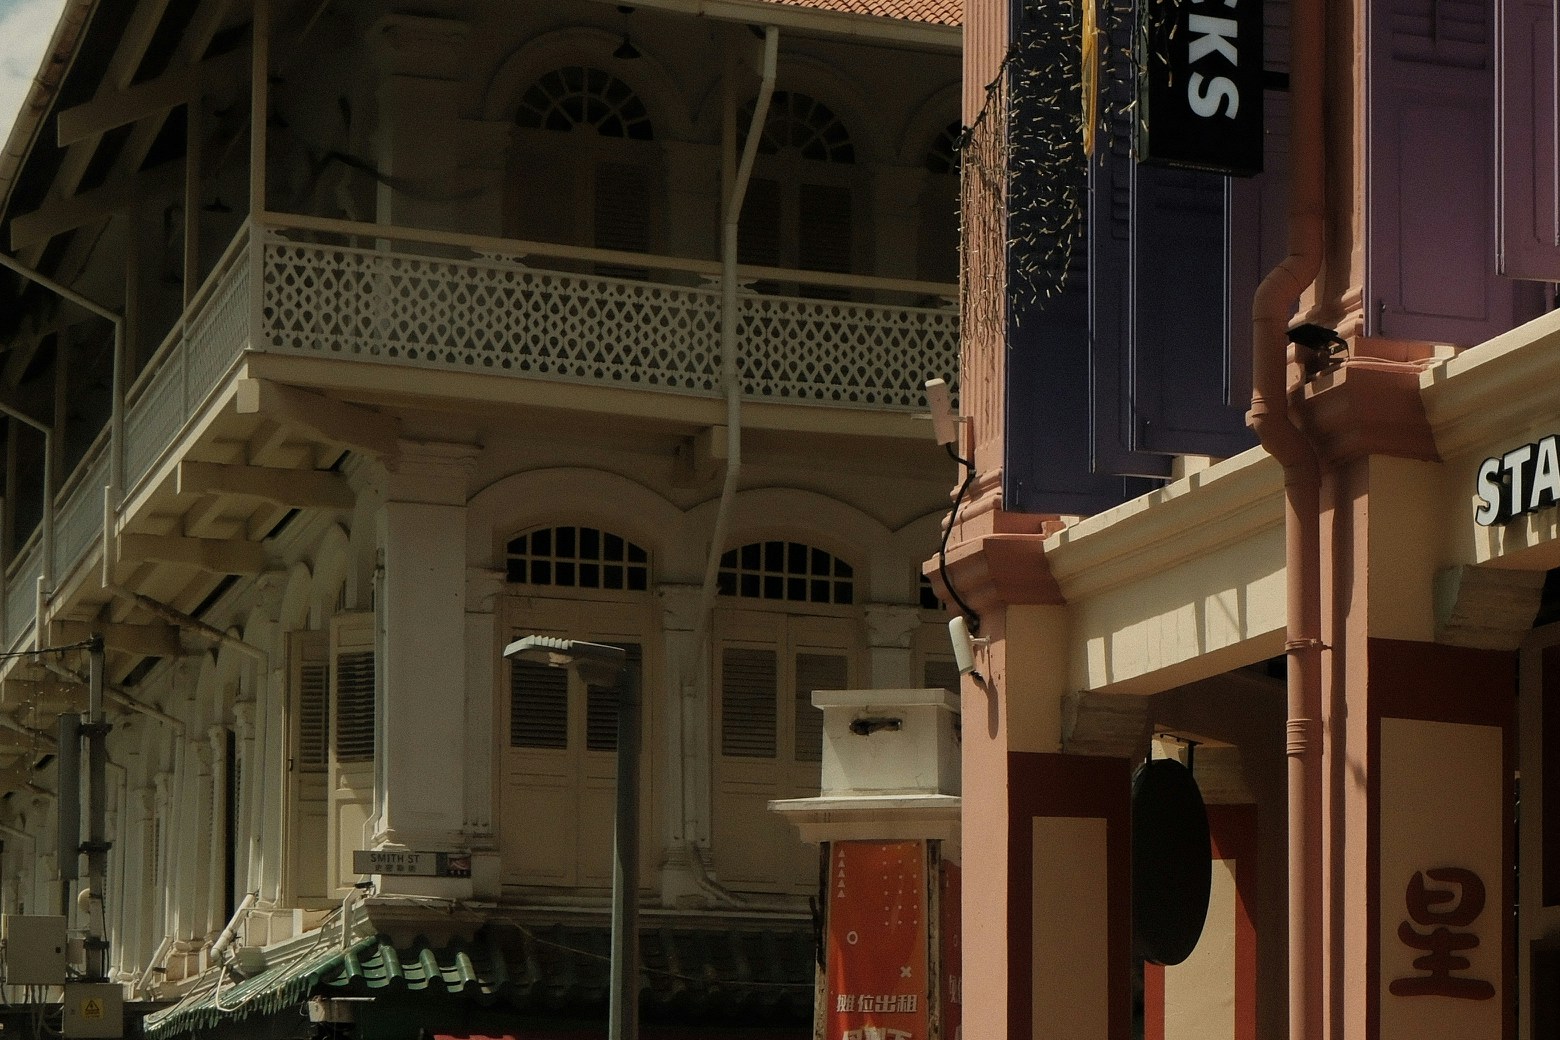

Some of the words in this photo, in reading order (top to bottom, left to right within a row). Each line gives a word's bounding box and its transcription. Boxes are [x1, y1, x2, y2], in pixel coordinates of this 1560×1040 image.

[1188, 0, 1240, 120] KS
[370, 853, 404, 863] SMITH
[408, 854, 420, 864] ST
[836, 994, 918, 1013] 摊位出租
